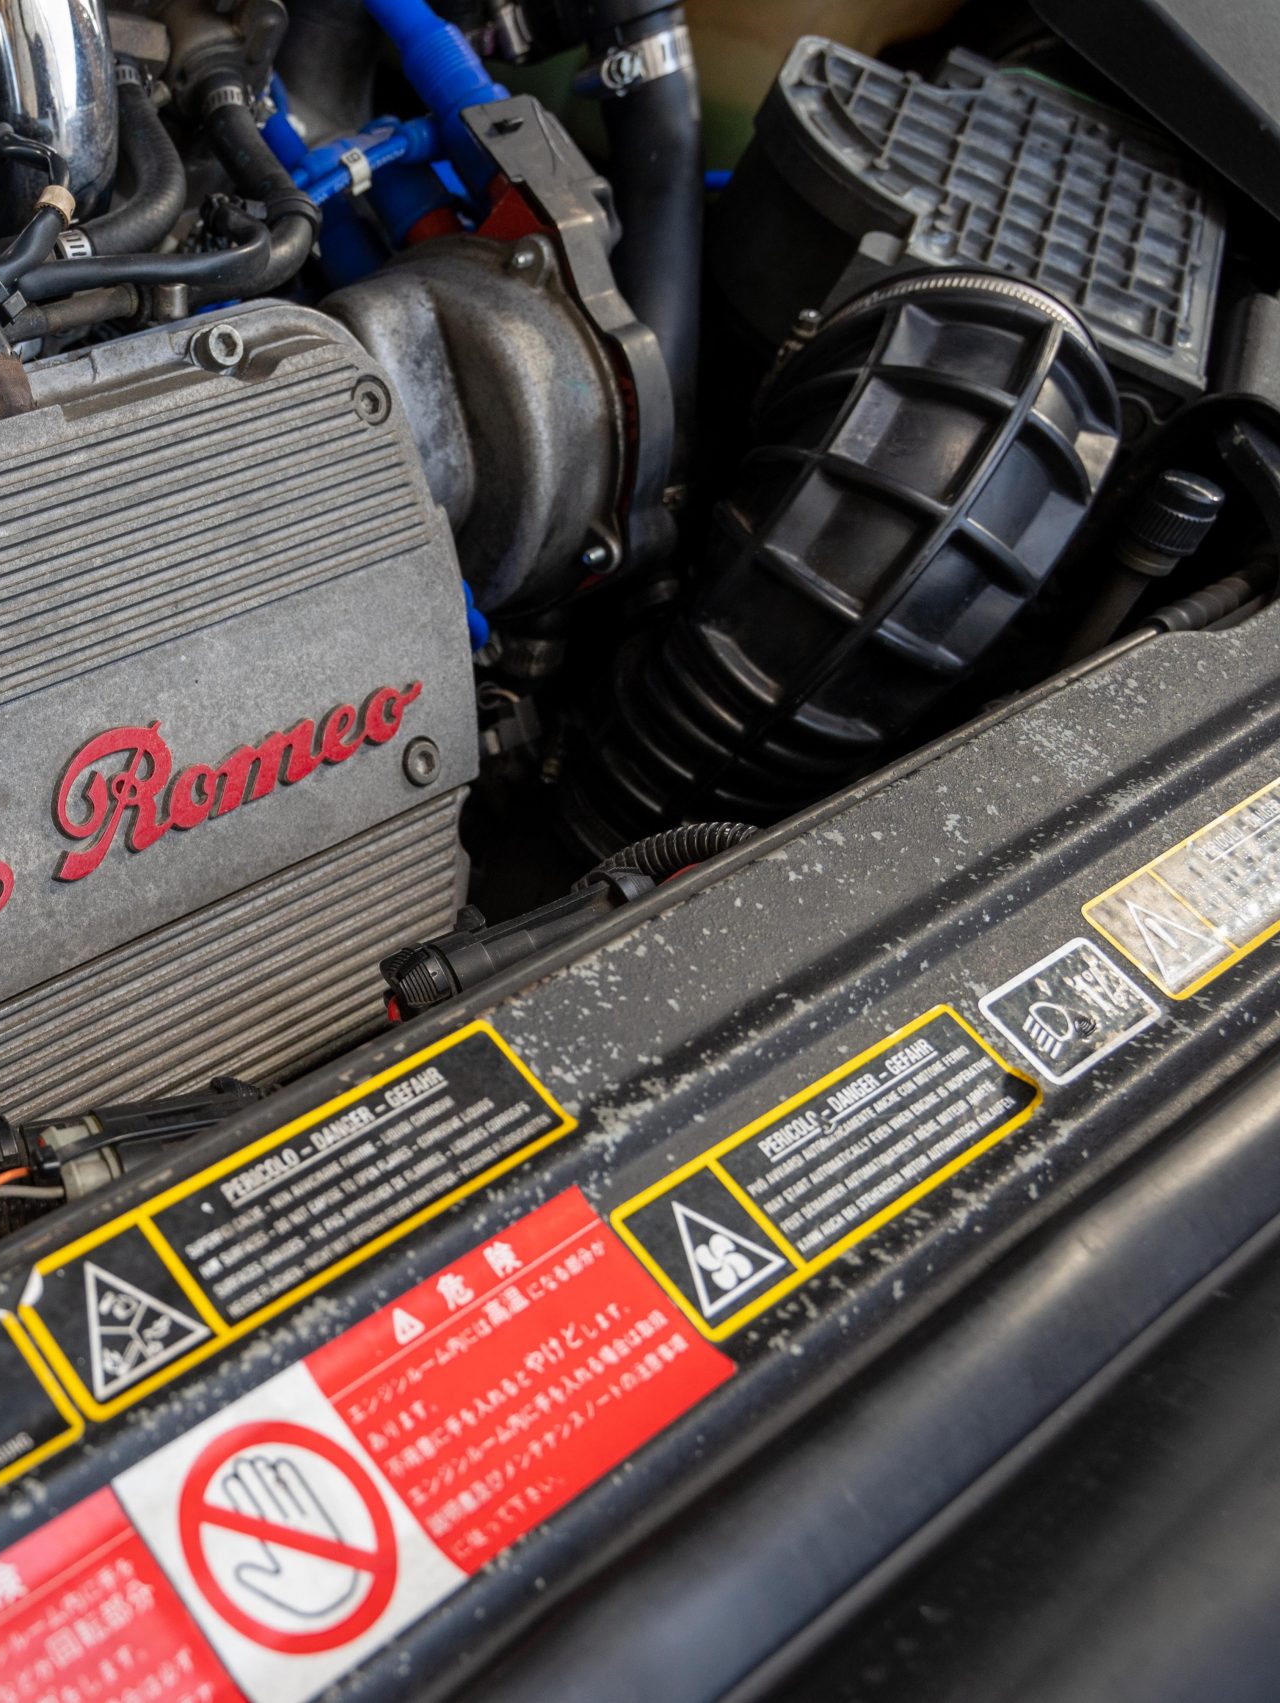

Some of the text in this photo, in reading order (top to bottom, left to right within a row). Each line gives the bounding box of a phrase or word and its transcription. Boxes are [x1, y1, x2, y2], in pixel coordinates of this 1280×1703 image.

[50, 680, 423, 882] Romeo
[825, 1071, 880, 1113] DANGER
[882, 1036, 935, 1076] GEFAHR
[870, 1089, 902, 1114] ANCHE
[895, 1079, 918, 1097] CON
[911, 1060, 947, 1087] MOTORE
[940, 1043, 972, 1067] FERMO
[217, 1145, 302, 1202] PERICOLO
[307, 1104, 377, 1151] DANGER
[381, 1065, 446, 1108] GEFAHR
[762, 1194, 788, 1216] MAY
[781, 1176, 814, 1203] START
[806, 1135, 873, 1185] AUTOMATICALLY
[867, 1122, 893, 1144] EVEN
[887, 1108, 915, 1131] WHEN
[908, 1090, 941, 1116] ENGINE
[943, 1055, 993, 1093] INOPERATIVE
[898, 1152, 931, 1180] MOTOR
